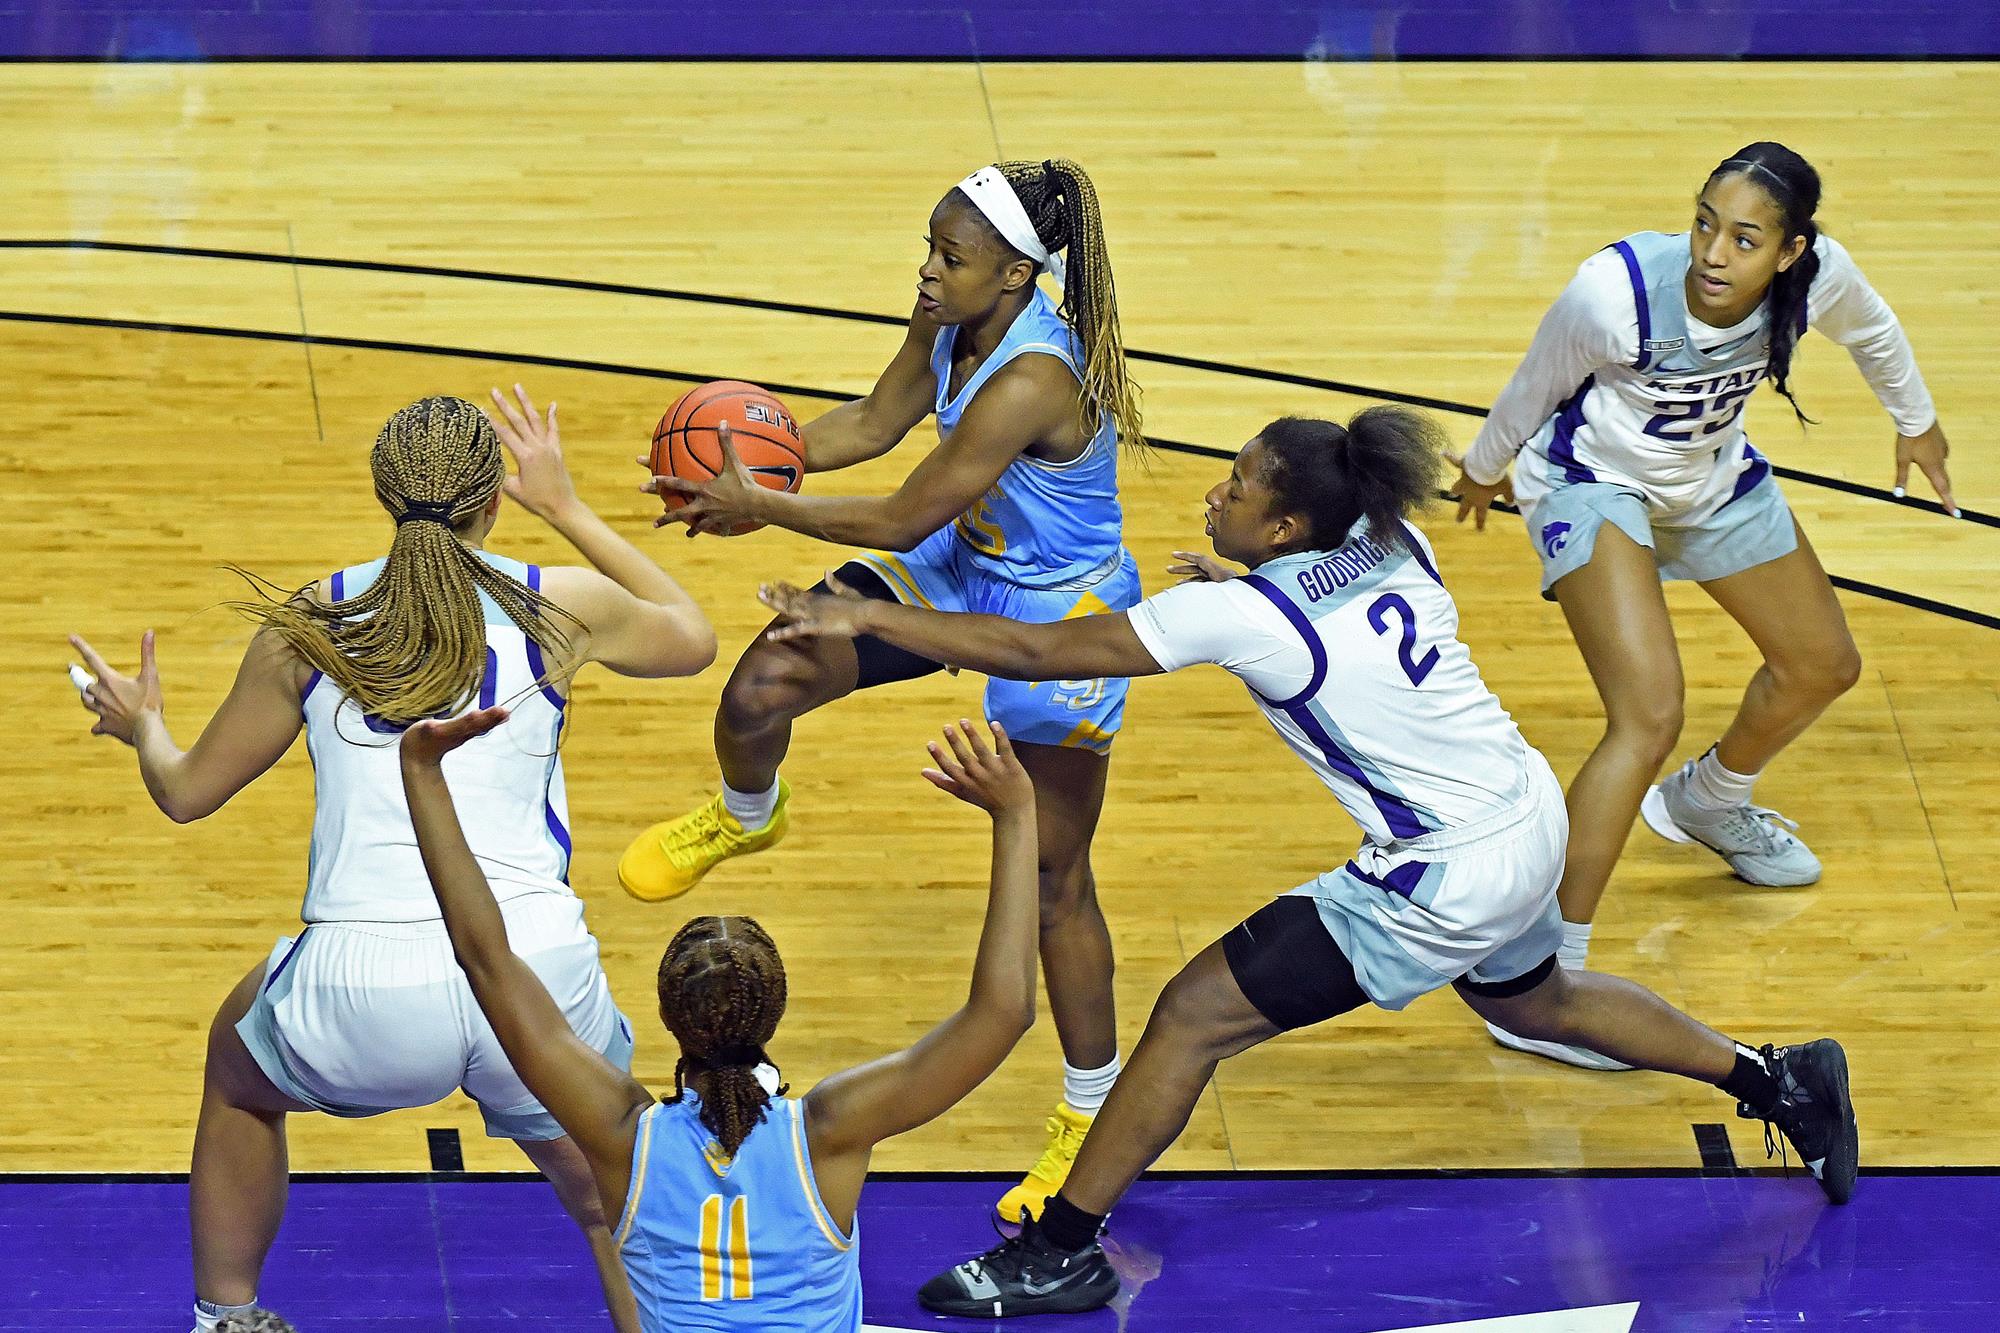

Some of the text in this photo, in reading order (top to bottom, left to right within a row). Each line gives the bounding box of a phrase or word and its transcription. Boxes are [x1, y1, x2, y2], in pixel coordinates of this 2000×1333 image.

[1646, 367, 1767, 395] K-STAT
[1367, 592, 1441, 688] 2
[698, 1193, 753, 1301] 11
